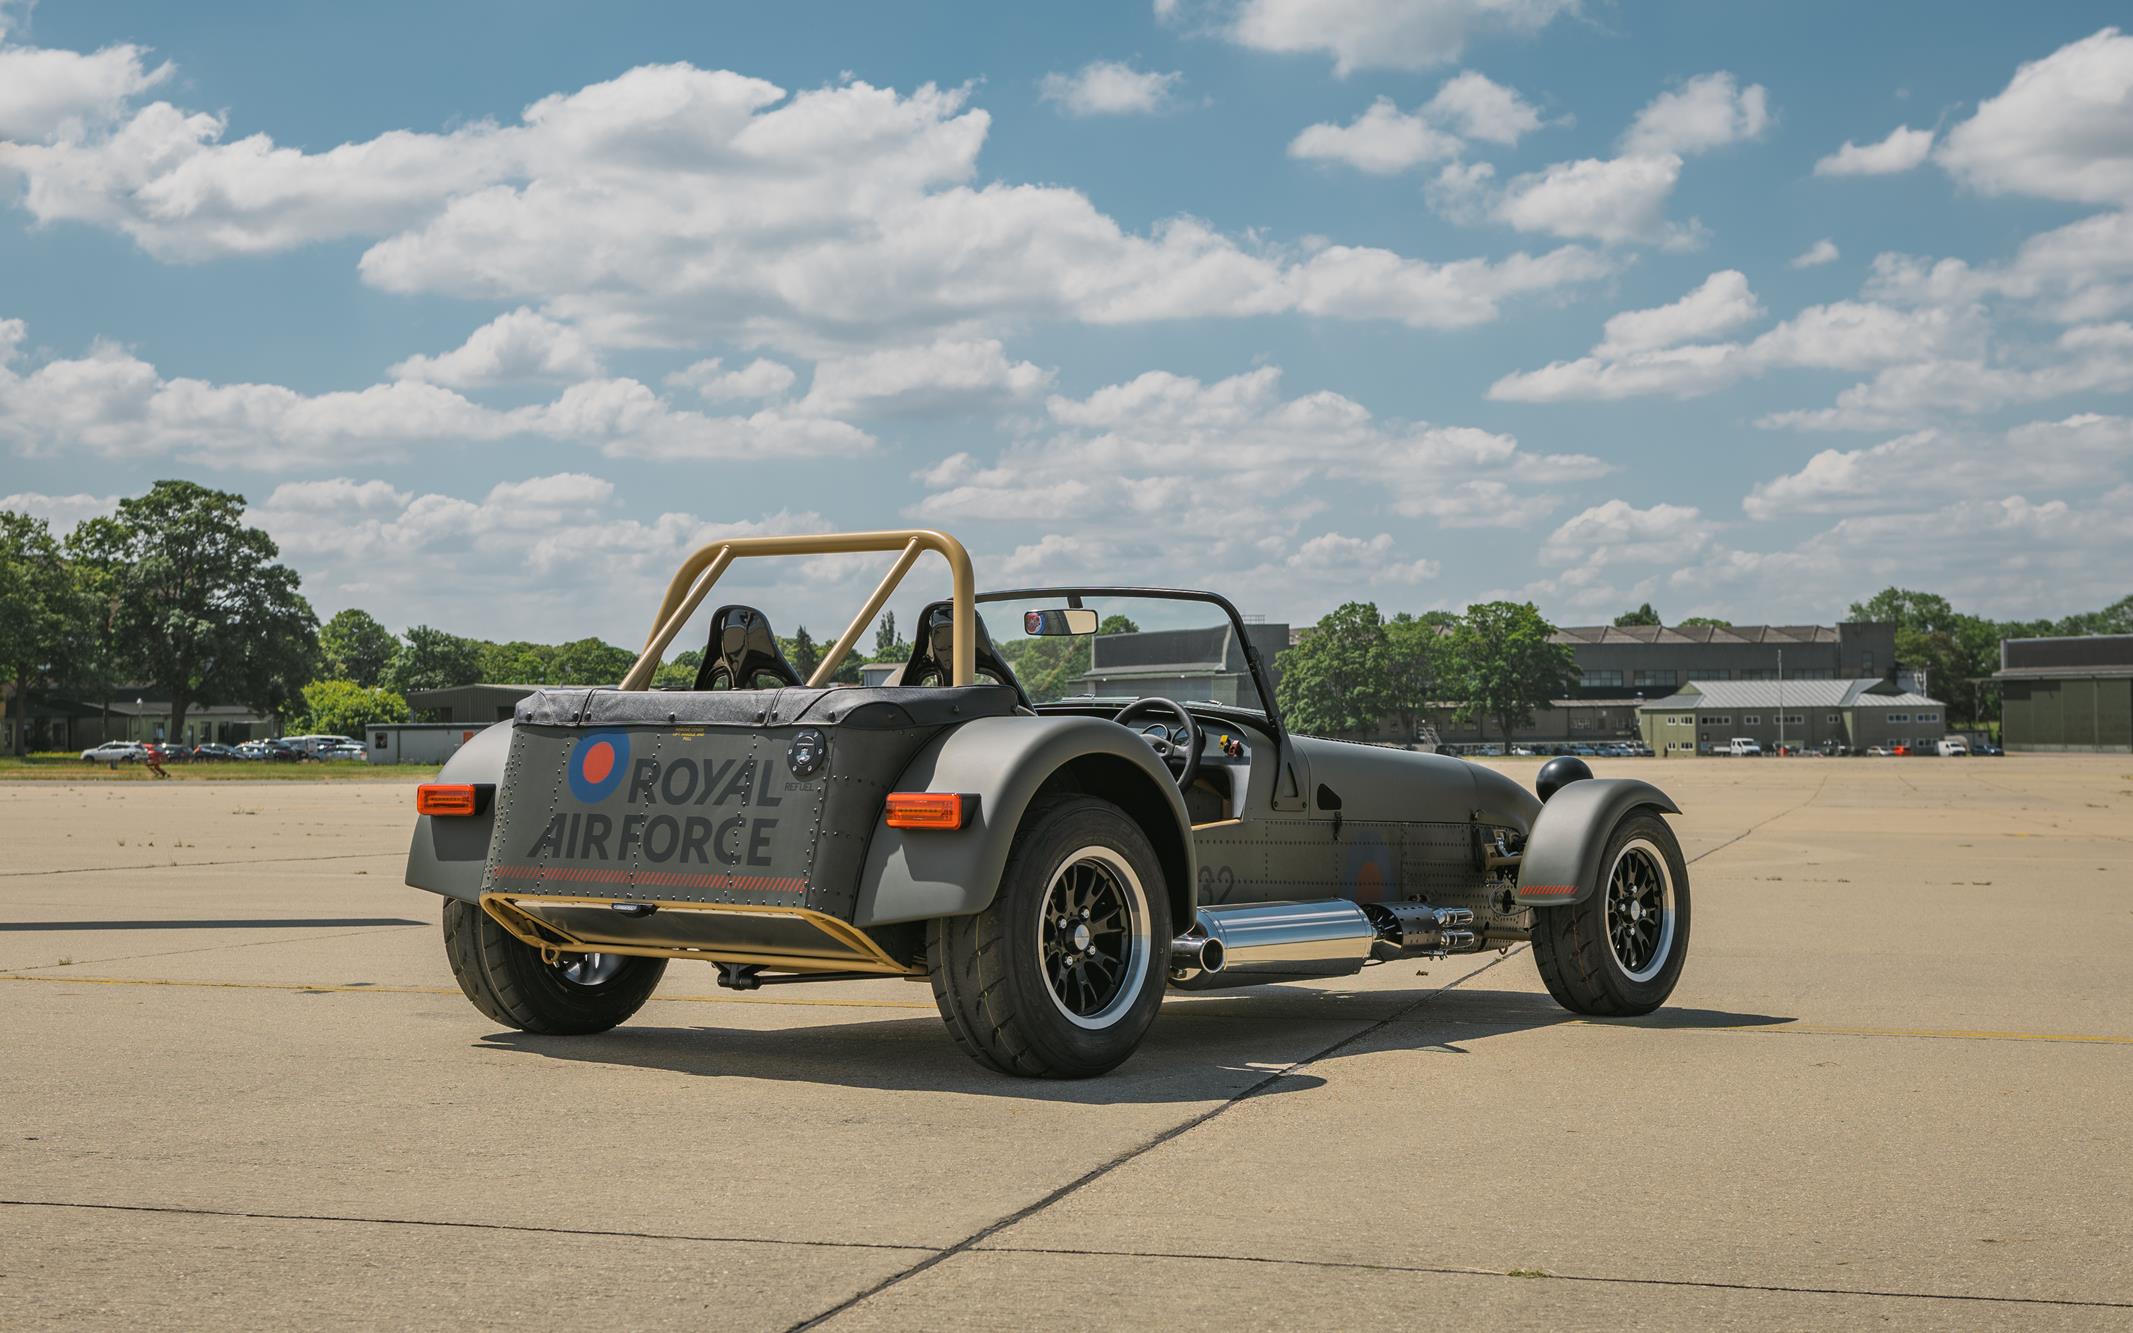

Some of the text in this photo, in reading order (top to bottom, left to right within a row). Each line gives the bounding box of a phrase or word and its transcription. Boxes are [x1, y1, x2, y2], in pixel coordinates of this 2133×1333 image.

[627, 757, 783, 807] ROYAL
[784, 781, 815, 792] REFUEL
[526, 812, 779, 866] AIR FORCE
